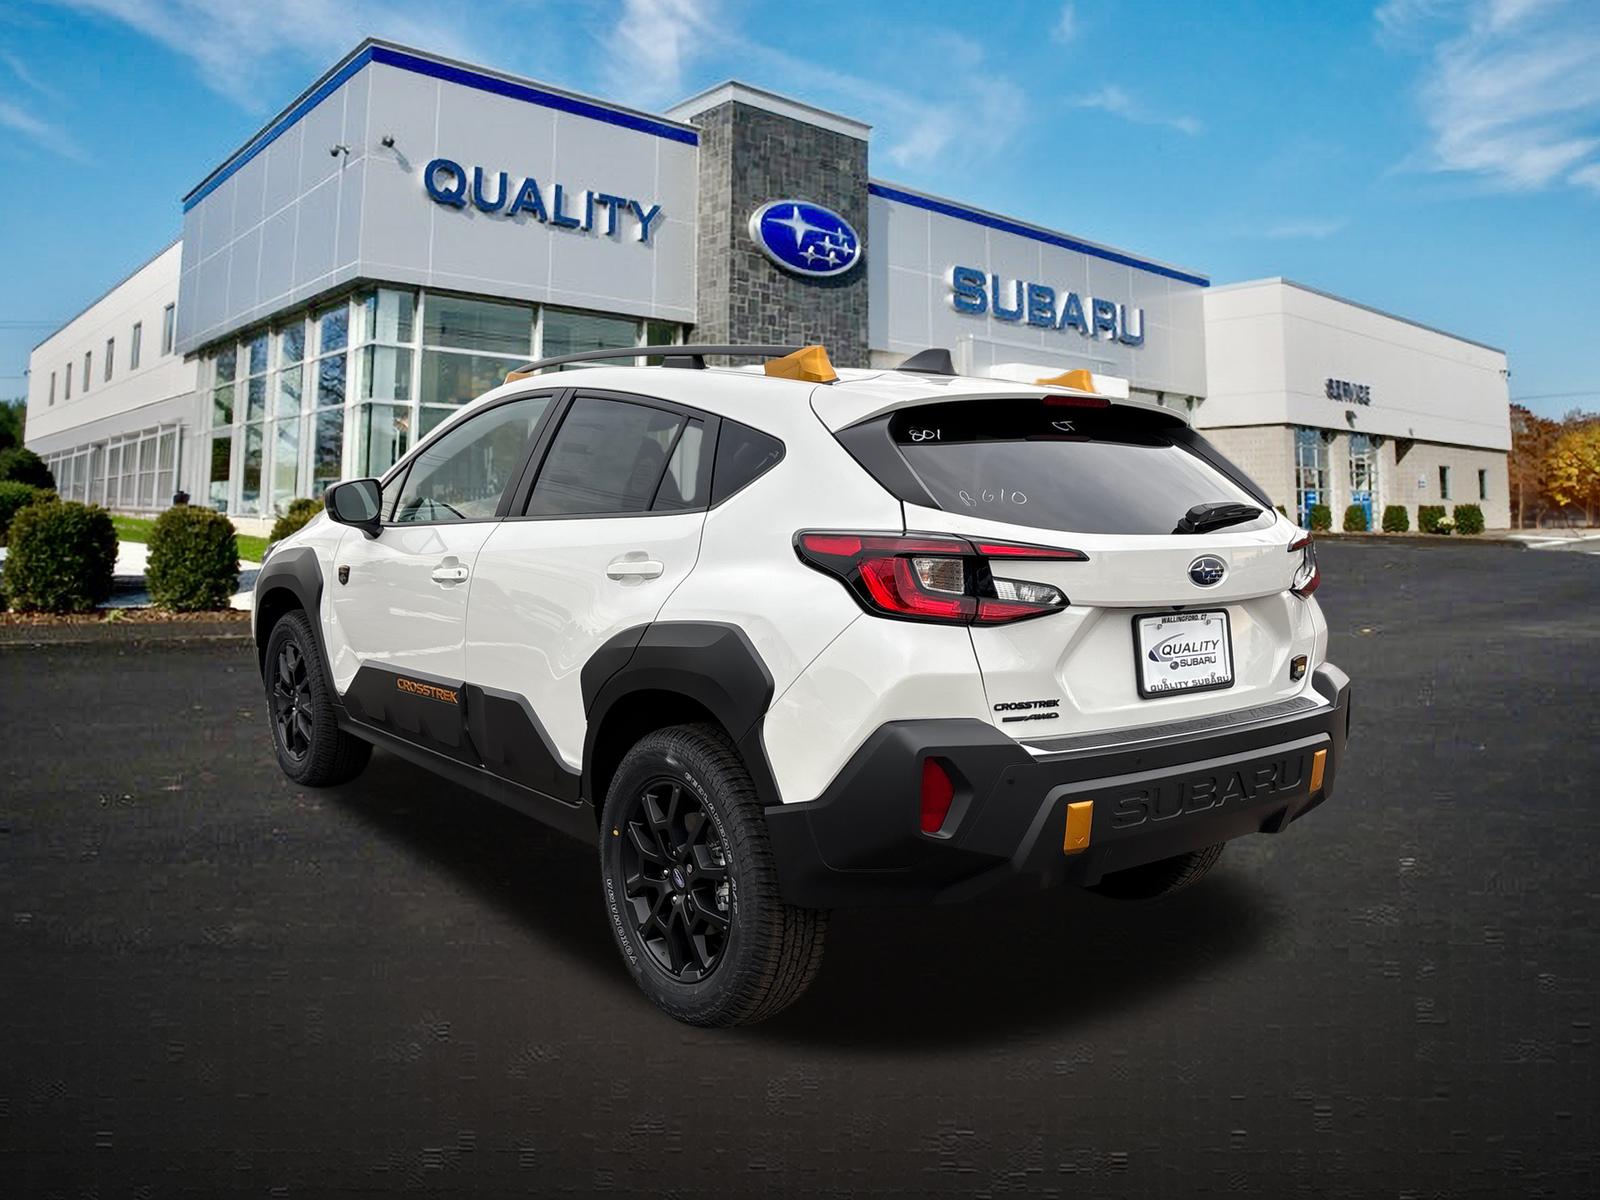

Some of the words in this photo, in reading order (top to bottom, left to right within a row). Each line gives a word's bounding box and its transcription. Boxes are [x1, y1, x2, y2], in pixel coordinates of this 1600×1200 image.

[424, 158, 661, 242] QUALITY
[949, 265, 1145, 346] SUBARU
[1161, 639, 1219, 656] QUALITY
[1180, 656, 1217, 667] SUBARU
[396, 678, 458, 704] CROSSTREK
[1150, 681, 1189, 691] QUALITY
[1191, 676, 1229, 686] SUBARU
[993, 699, 1060, 711] CROSSTREK
[1111, 755, 1304, 829] SUBARU
